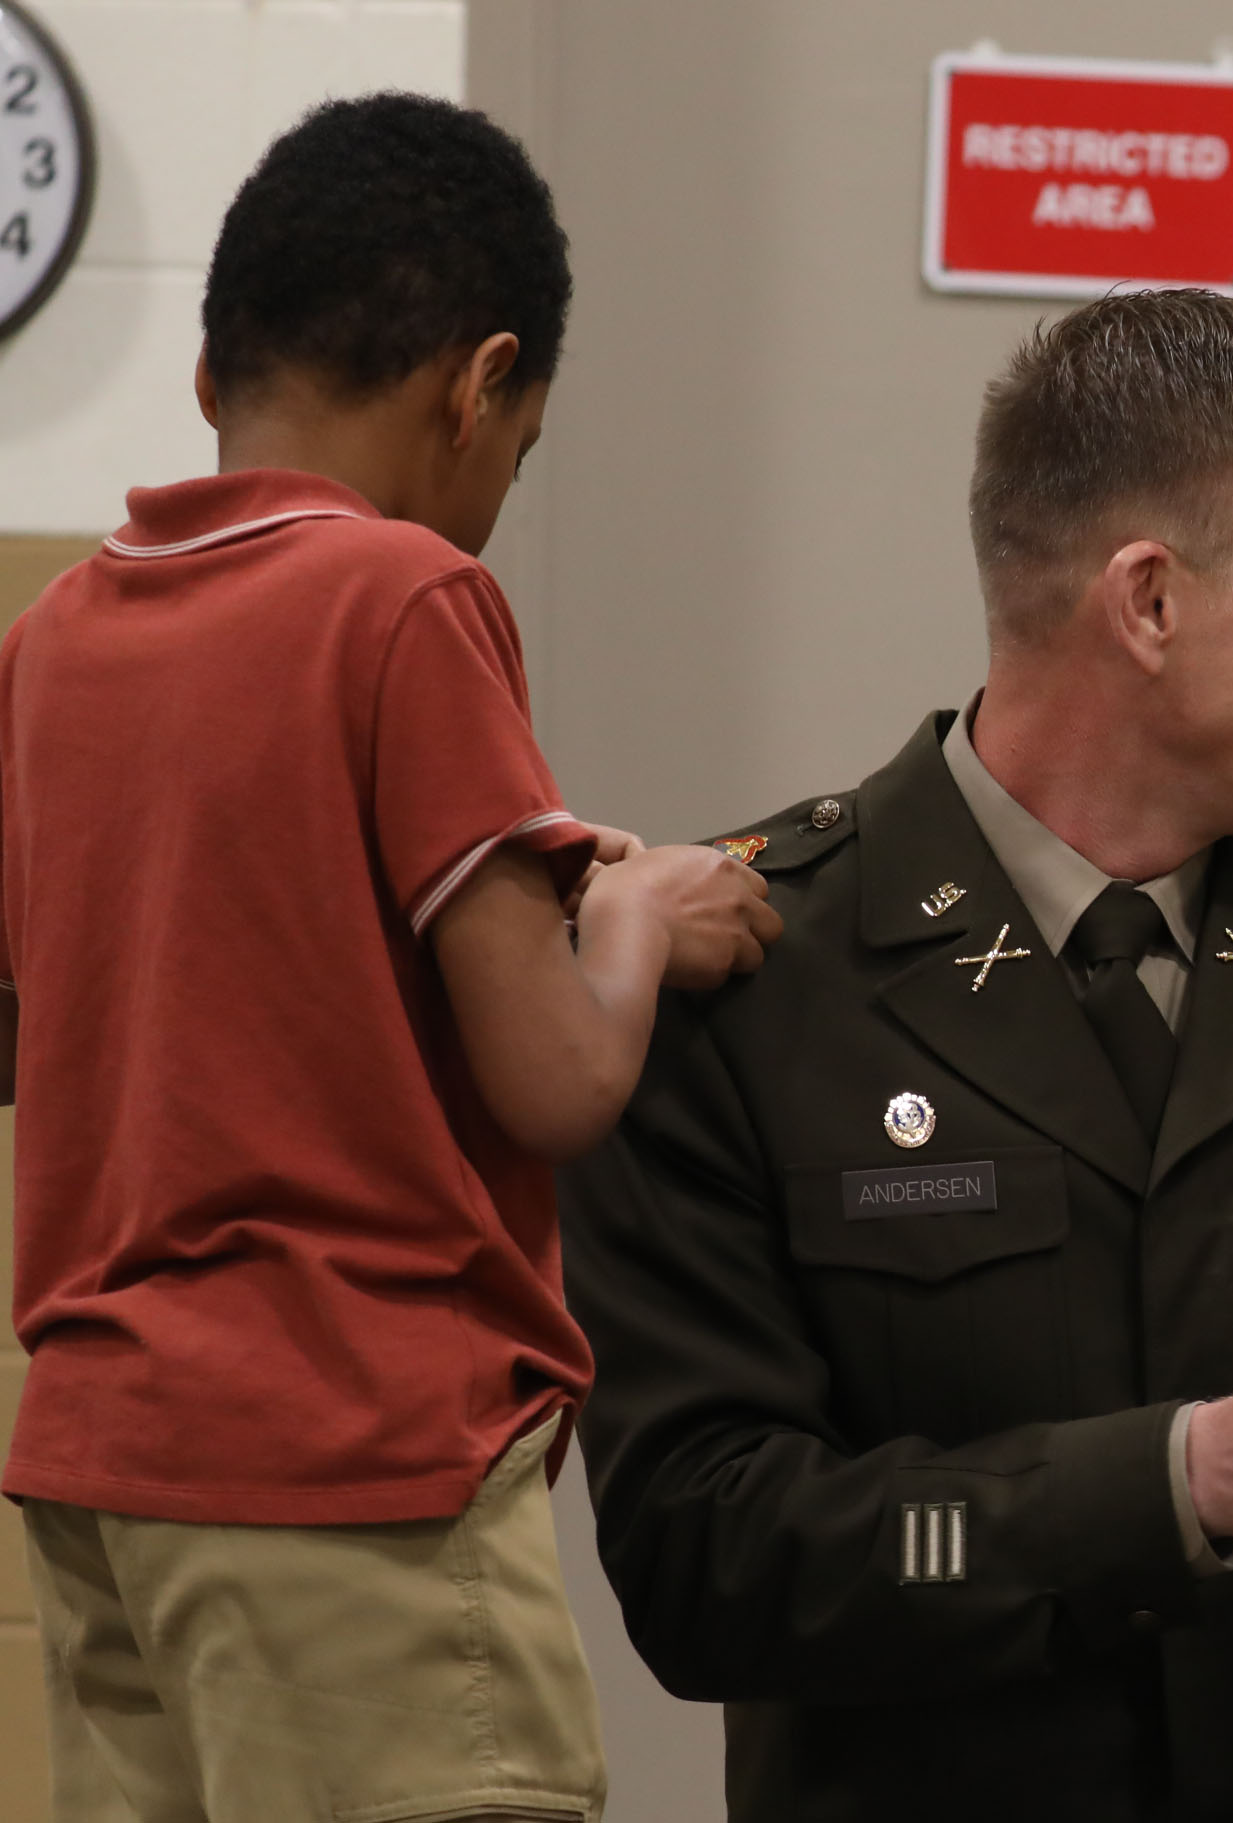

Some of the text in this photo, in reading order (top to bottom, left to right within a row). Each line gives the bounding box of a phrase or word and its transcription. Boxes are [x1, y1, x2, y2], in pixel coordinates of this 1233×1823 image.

[5, 65, 39, 114] 2
[23, 137, 56, 190] 3
[962, 123, 1229, 180] RESTRICTED
[1032, 182, 1155, 231] AREA
[0, 212, 31, 258] 4
[859, 1176, 982, 1205] ANDERSEN
